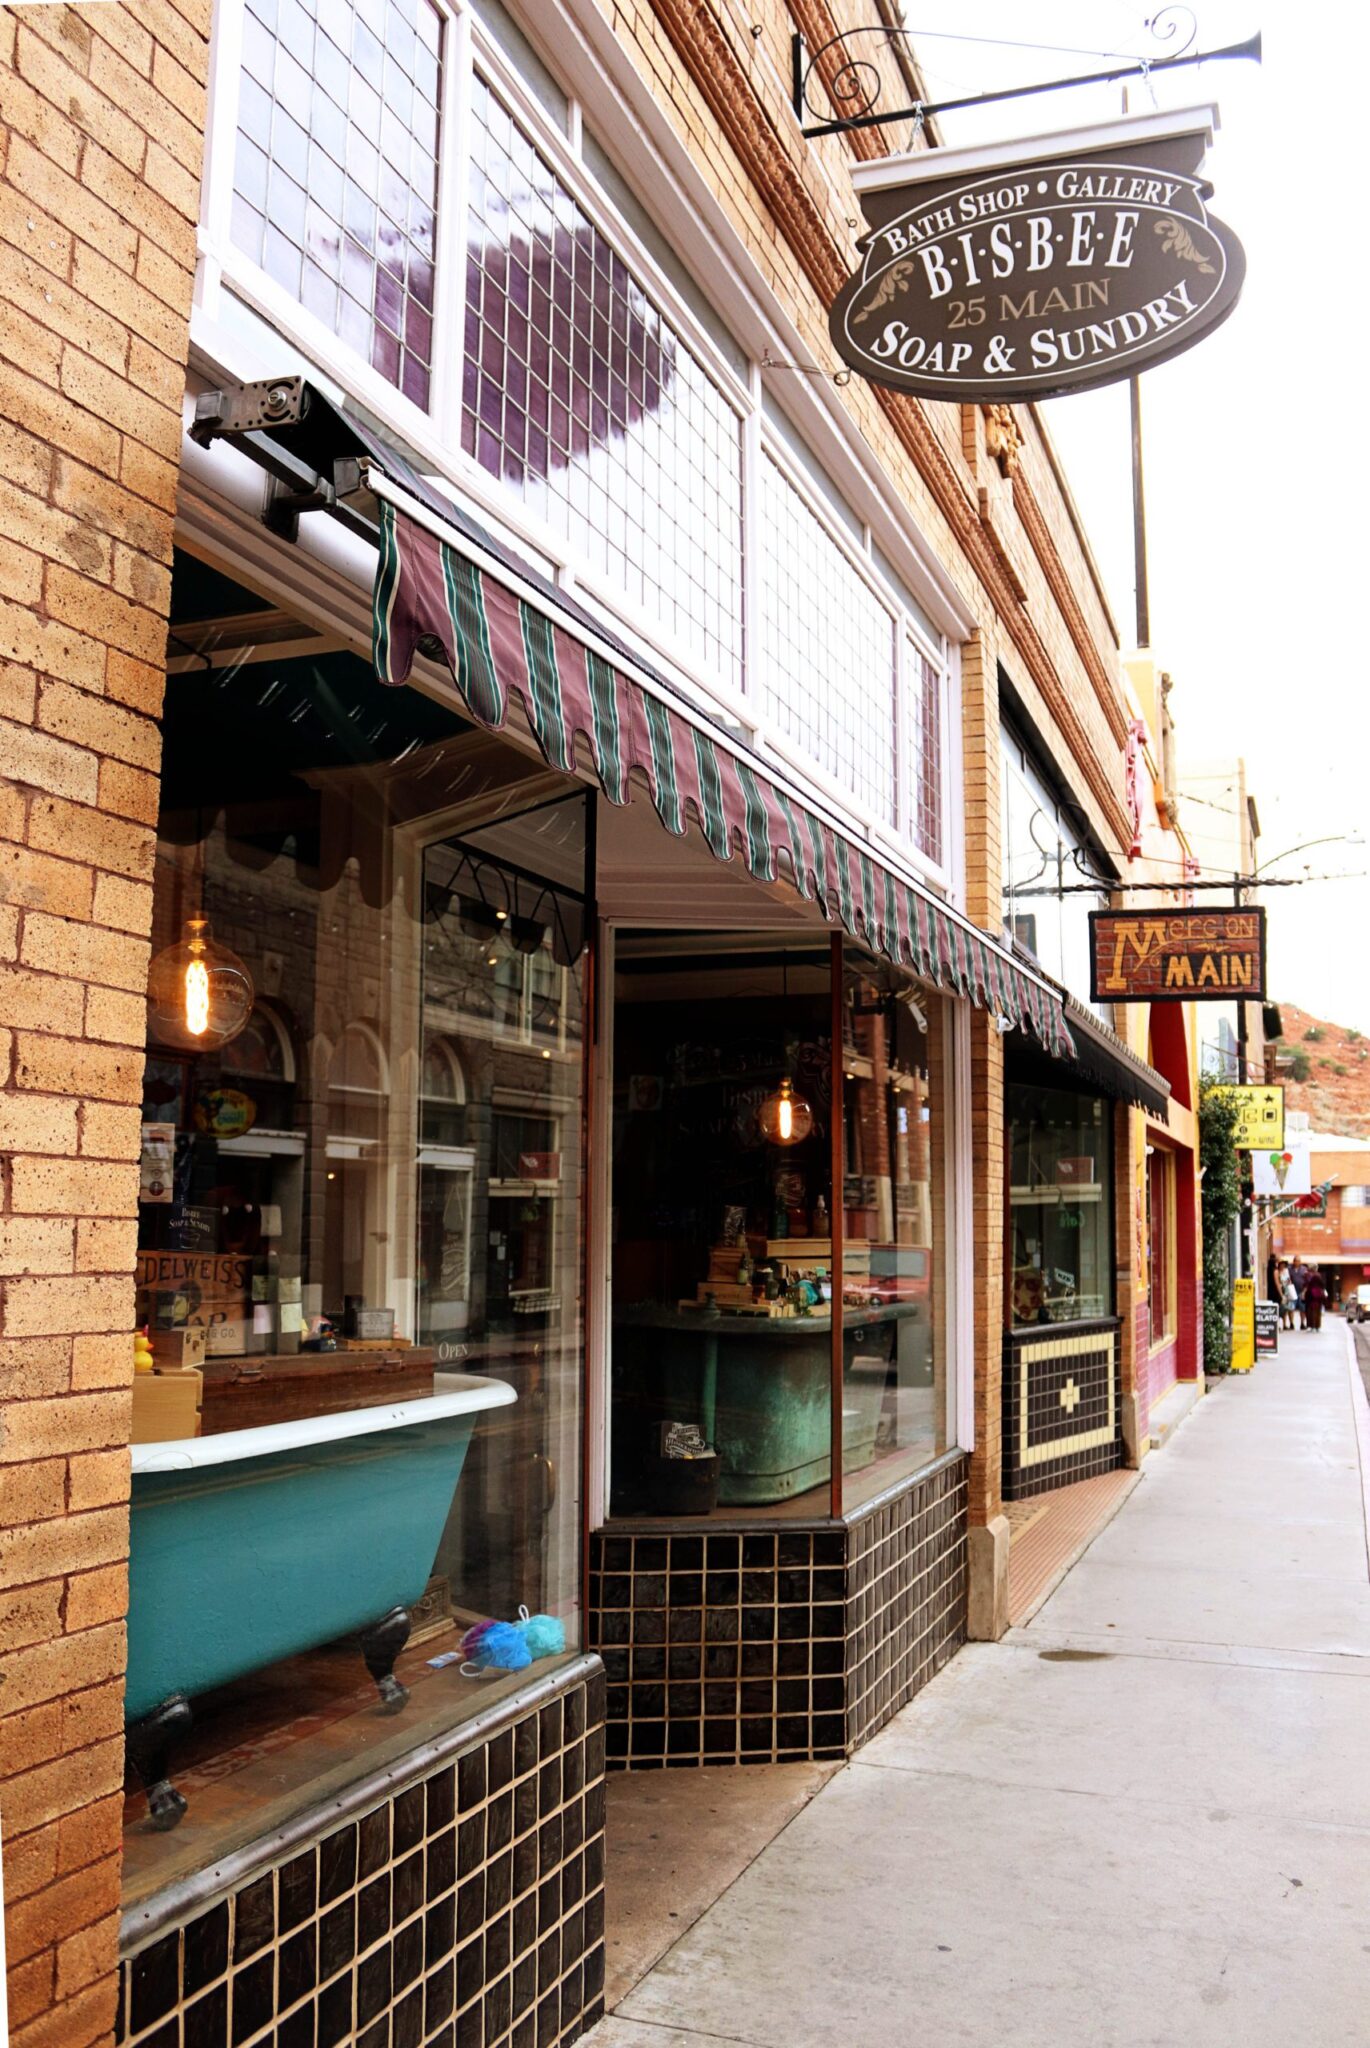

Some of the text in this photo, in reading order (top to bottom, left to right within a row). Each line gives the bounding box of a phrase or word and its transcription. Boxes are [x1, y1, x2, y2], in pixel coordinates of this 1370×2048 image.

[884, 171, 1182, 256] BATH SHOP GALLERY
[947, 278, 1112, 330] 25 MAIN
[870, 279, 1199, 374] SOAP & SUNDRY
[1226, 918, 1253, 937] ON
[1165, 954, 1252, 987] MAIN
[438, 1341, 468, 1360] OPEN
